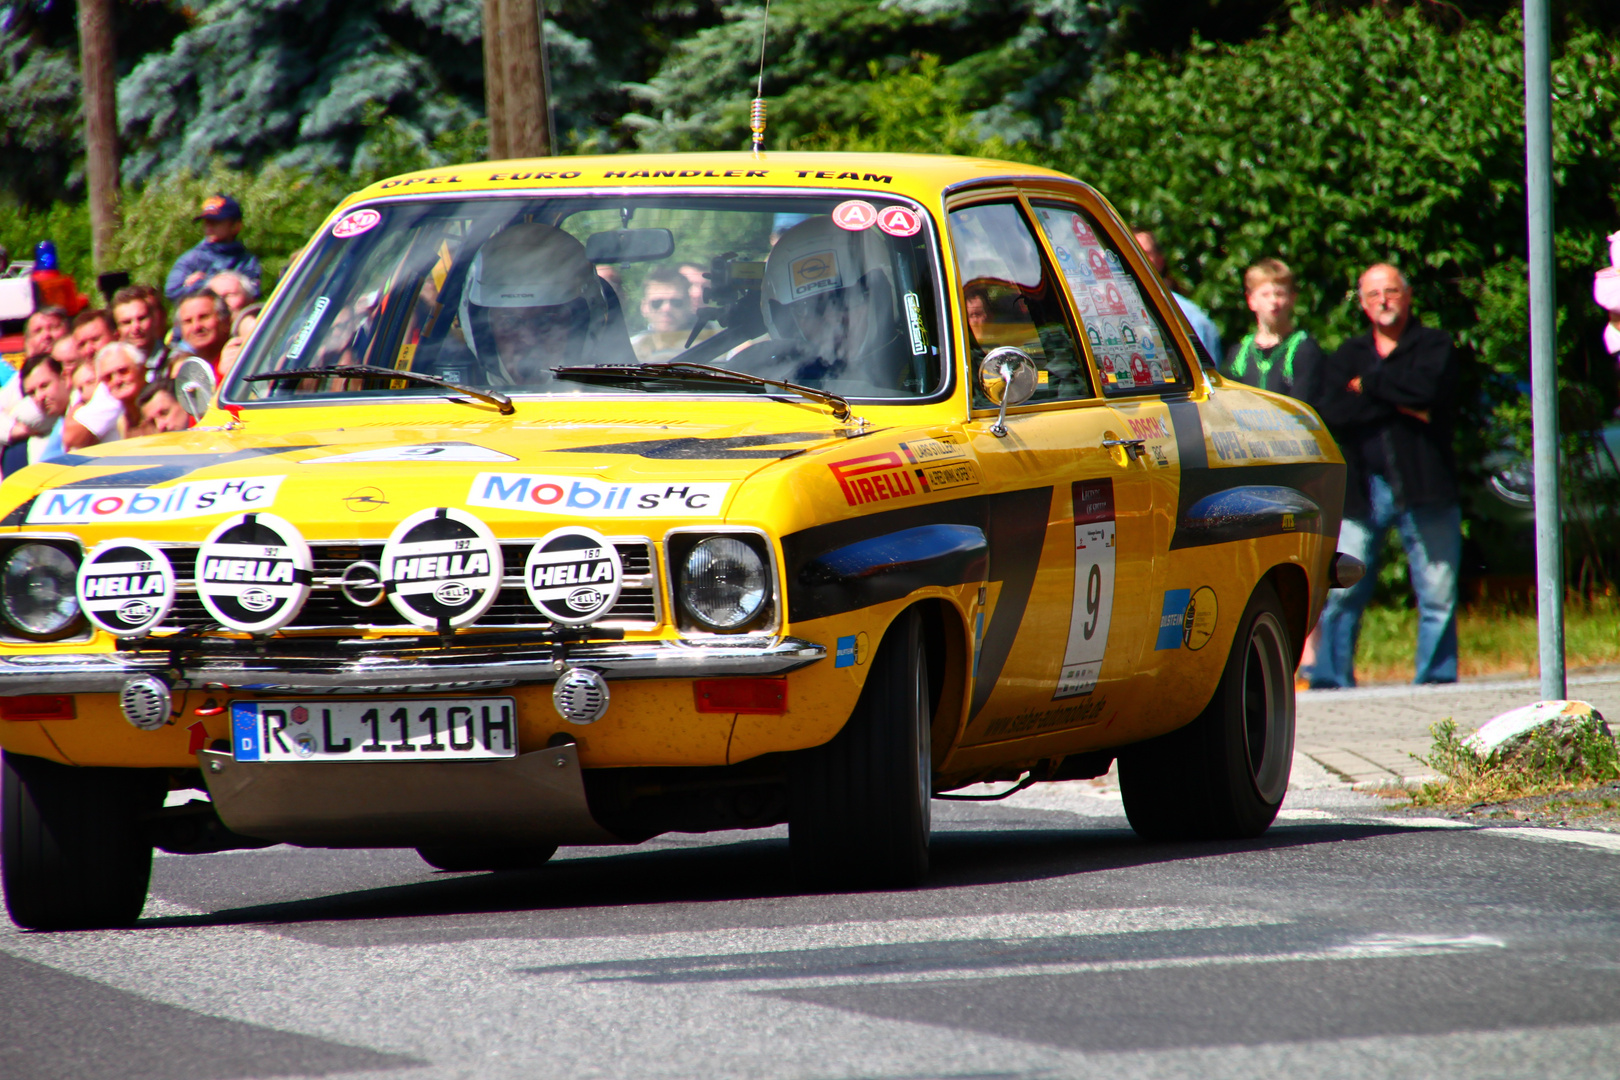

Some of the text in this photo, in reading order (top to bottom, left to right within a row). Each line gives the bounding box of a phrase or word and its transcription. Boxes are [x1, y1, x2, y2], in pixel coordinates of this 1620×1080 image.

[381, 169, 893, 189] OPEL EURO HÄNDLER TEAM
[843, 206, 866, 223] A
[888, 212, 911, 229] A
[796, 279, 837, 294] OPEL
[1127, 416, 1165, 439] BOSCH
[408, 447, 446, 456] 9
[1210, 431, 1248, 460] OPEL
[827, 451, 916, 507] PIRELLI
[44, 480, 265, 516] Mobil SHC
[482, 475, 710, 510] Mobil SHC
[204, 559, 293, 582] HELLA
[393, 552, 488, 579] HELLA
[533, 561, 612, 587] HELLA
[85, 574, 164, 597] HELLA
[1083, 564, 1101, 641] 9
[1160, 613, 1184, 628] BILSTEIN
[263, 709, 291, 754] R
[241, 738, 251, 751] D
